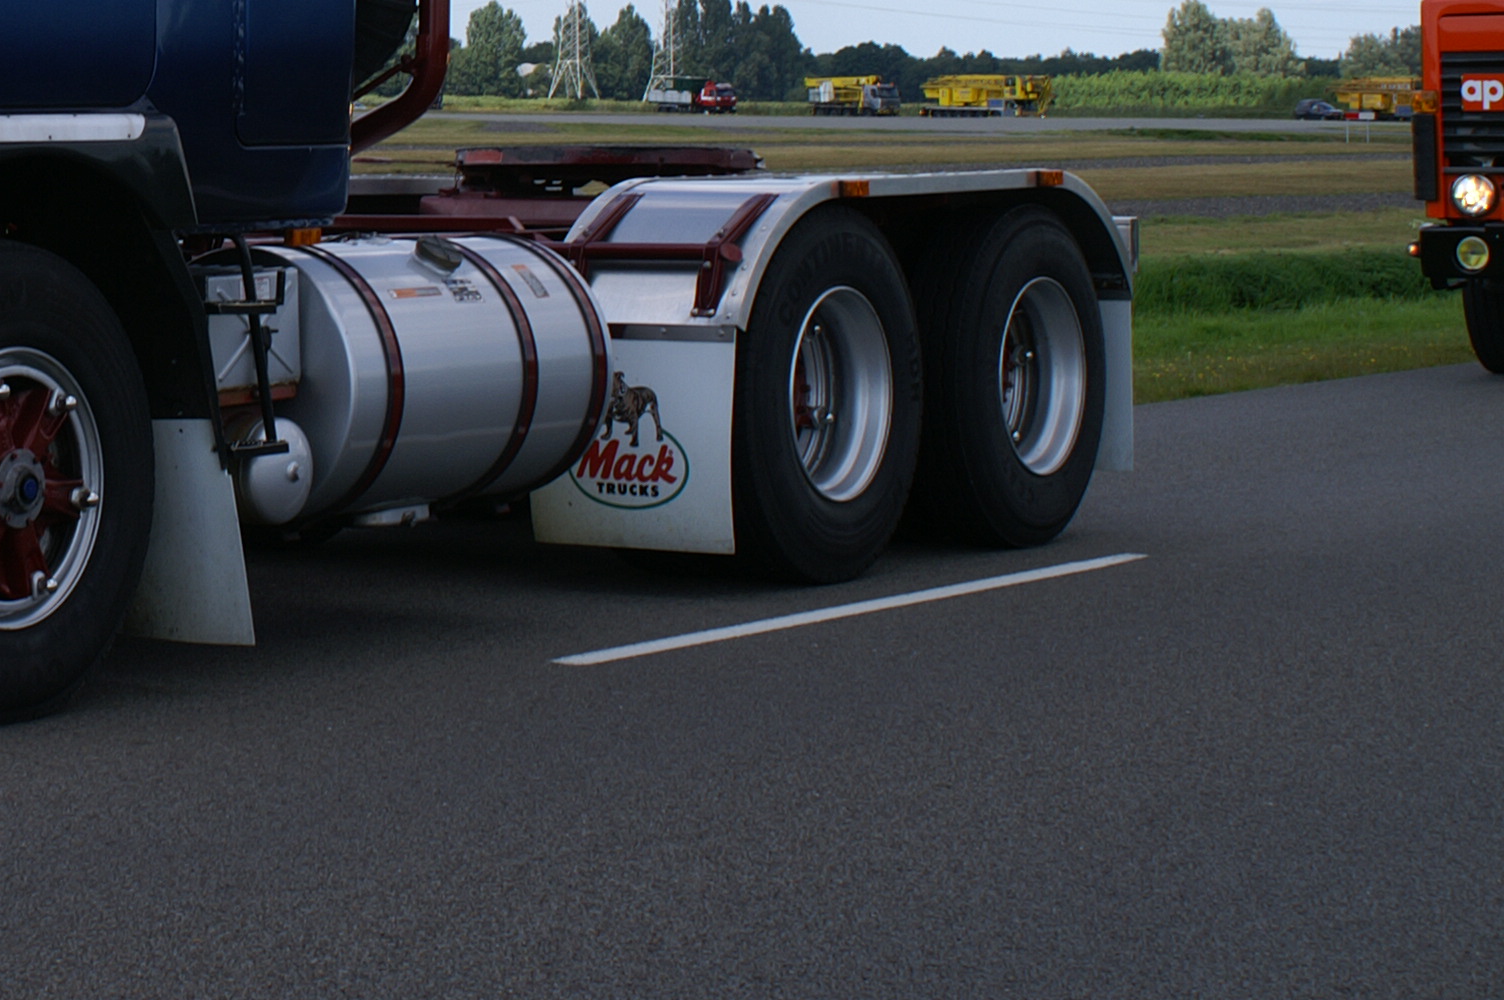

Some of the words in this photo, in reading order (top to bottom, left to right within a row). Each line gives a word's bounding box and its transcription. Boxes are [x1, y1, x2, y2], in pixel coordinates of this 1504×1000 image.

[1460, 79, 1504, 110] ap
[577, 438, 677, 484] Mack
[596, 481, 660, 498] TRUCKS
